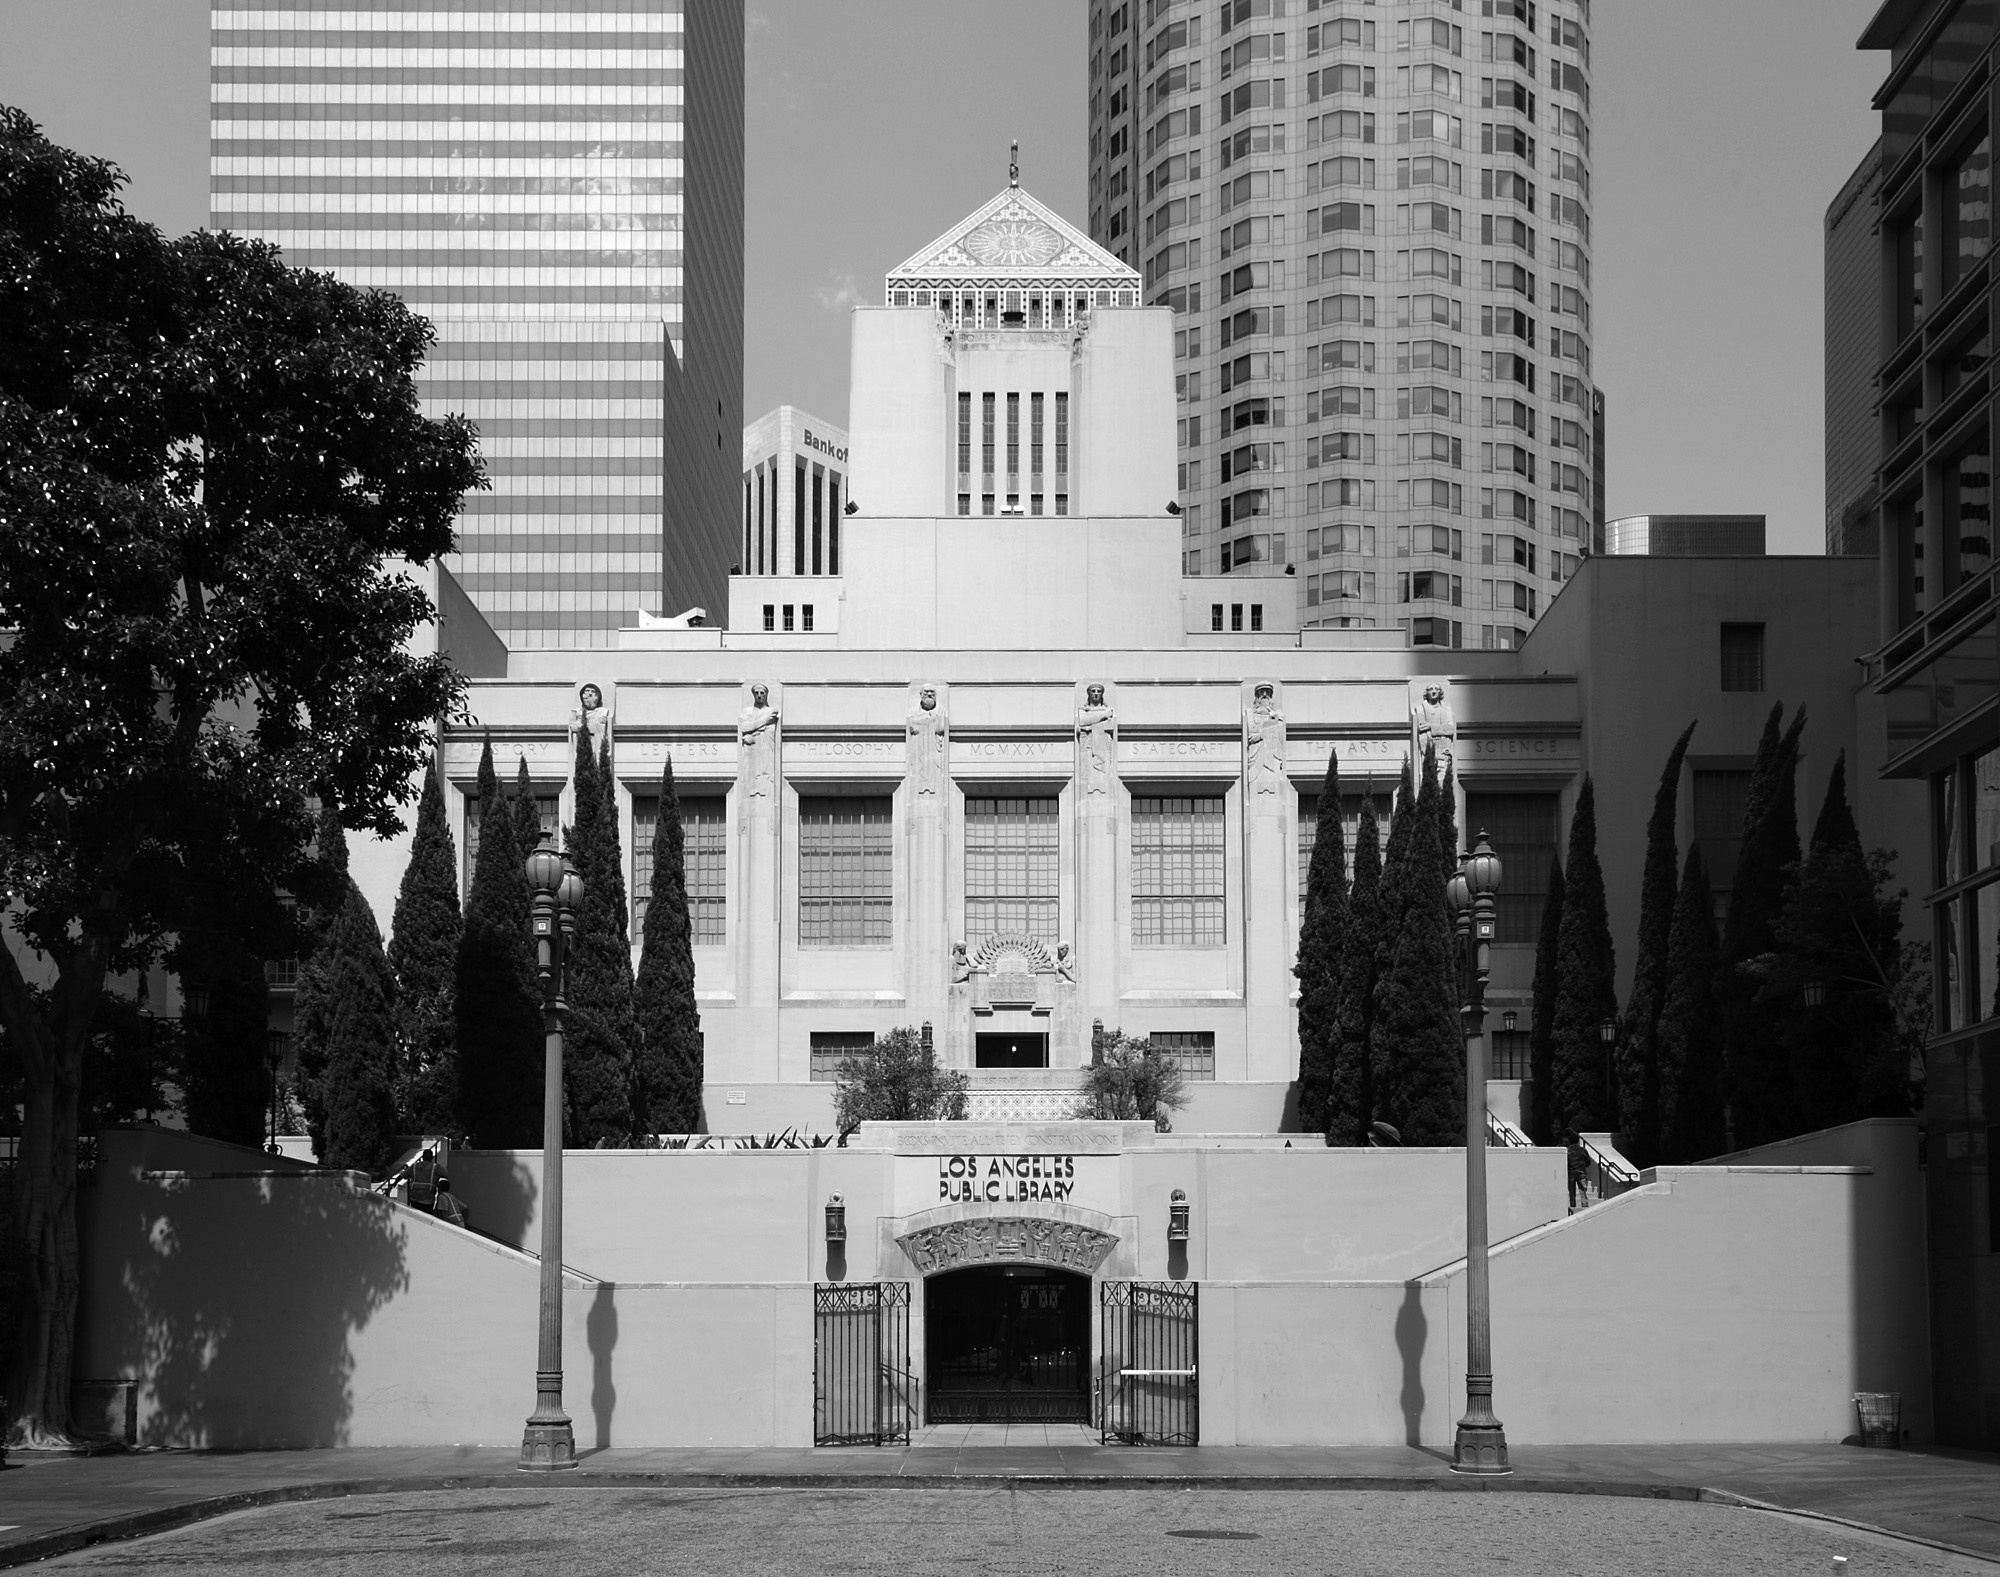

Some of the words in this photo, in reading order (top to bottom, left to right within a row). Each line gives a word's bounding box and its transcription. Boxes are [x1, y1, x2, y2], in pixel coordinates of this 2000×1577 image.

[1029, 333, 1070, 343] MILTON
[803, 428, 835, 458] Bank
[470, 743, 549, 756] HSTORY
[641, 743, 718, 756] LETTERS
[799, 743, 895, 756] PHILOSOPHY
[969, 743, 1055, 756] MCMXXVI
[1132, 743, 1225, 755] STATECRAFT
[1347, 741, 1388, 753] ARTS
[1475, 740, 1557, 753] SCIENCE
[940, 1156, 977, 1178] LOS
[988, 1156, 1074, 1178] ANGELES
[940, 1180, 1000, 1202] PUBLIC
[1006, 1180, 1074, 1202] LIBRARY
